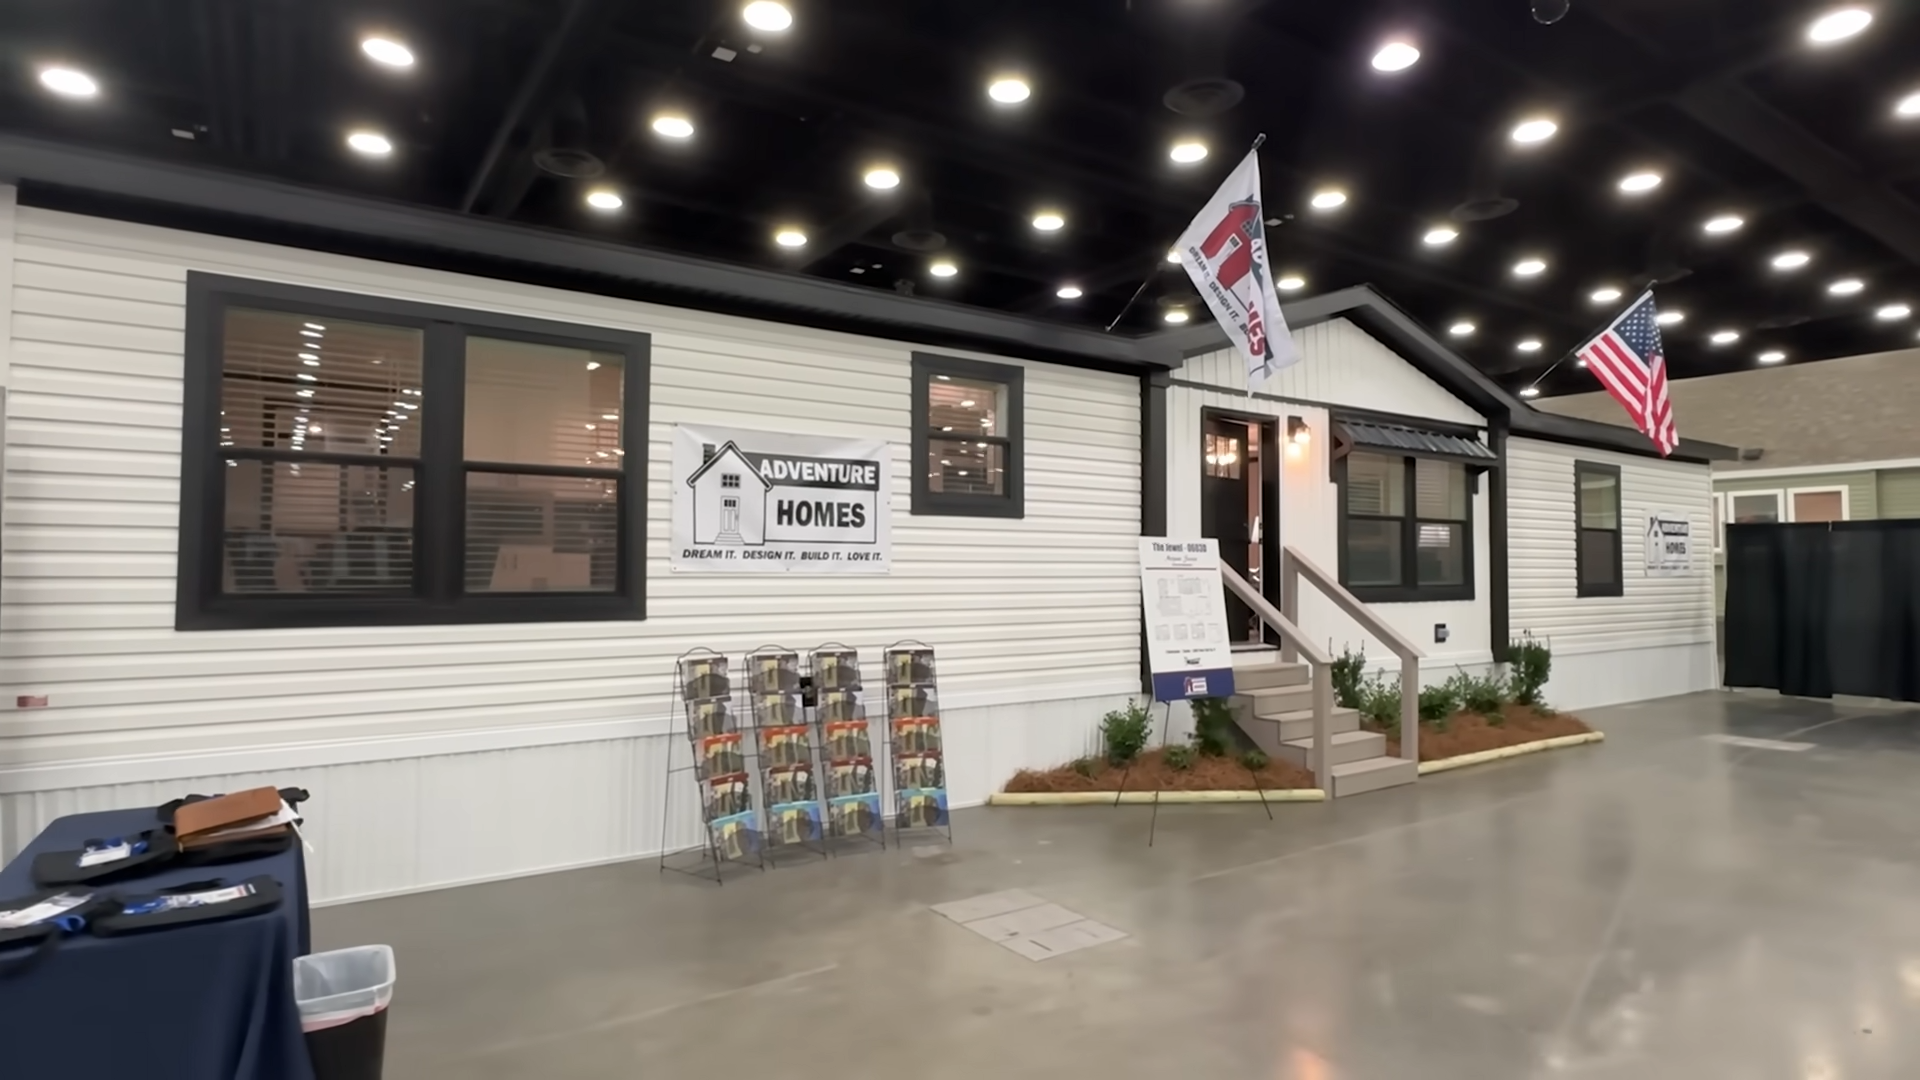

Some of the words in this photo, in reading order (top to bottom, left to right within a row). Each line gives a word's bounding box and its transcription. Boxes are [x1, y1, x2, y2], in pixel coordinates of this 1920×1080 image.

[1208, 281, 1233, 312] DESIGN
[1229, 310, 1240, 322] IT.
[760, 458, 876, 485] ADVENTURE
[776, 499, 866, 528] HOMES
[682, 549, 723, 560] DREAM
[725, 550, 737, 560] IT.
[743, 550, 782, 561] DESIGN
[784, 551, 796, 561] IT.
[800, 551, 830, 561] BUILD
[832, 552, 842, 561] IT.
[847, 552, 871, 561] LOVE
[872, 552, 883, 561] IT.
